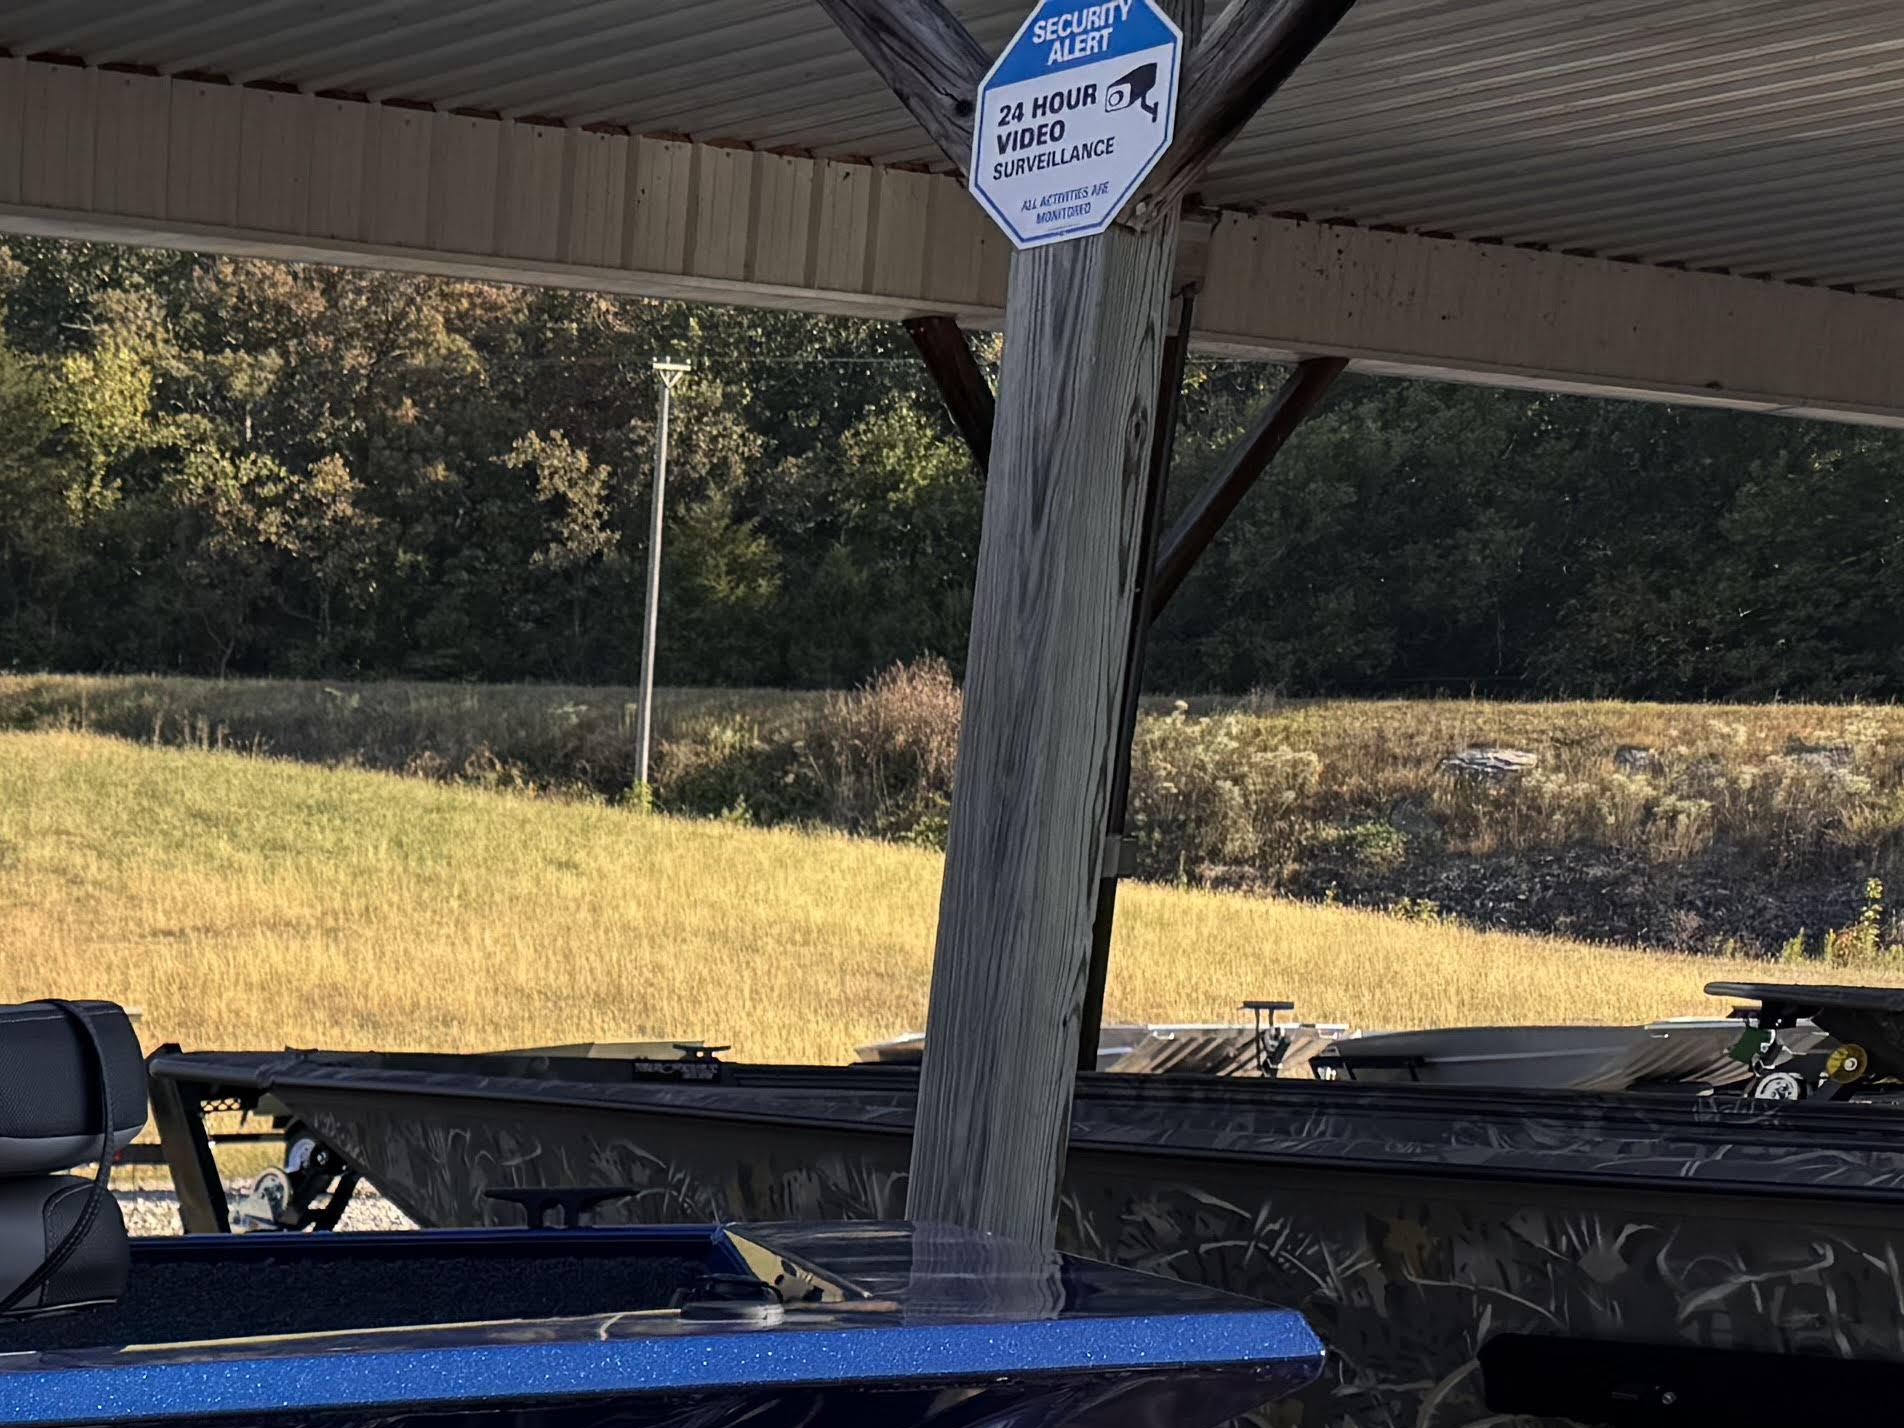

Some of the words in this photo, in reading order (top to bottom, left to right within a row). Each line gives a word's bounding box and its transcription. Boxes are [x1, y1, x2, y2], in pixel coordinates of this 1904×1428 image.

[1032, 0, 1132, 44] SECURITY
[1048, 28, 1113, 66] ALERT
[997, 102, 1024, 127] 24
[1032, 84, 1097, 119] HOUR
[992, 137, 1115, 180] SURVEILLANCE
[997, 120, 1065, 155] VIDEO
